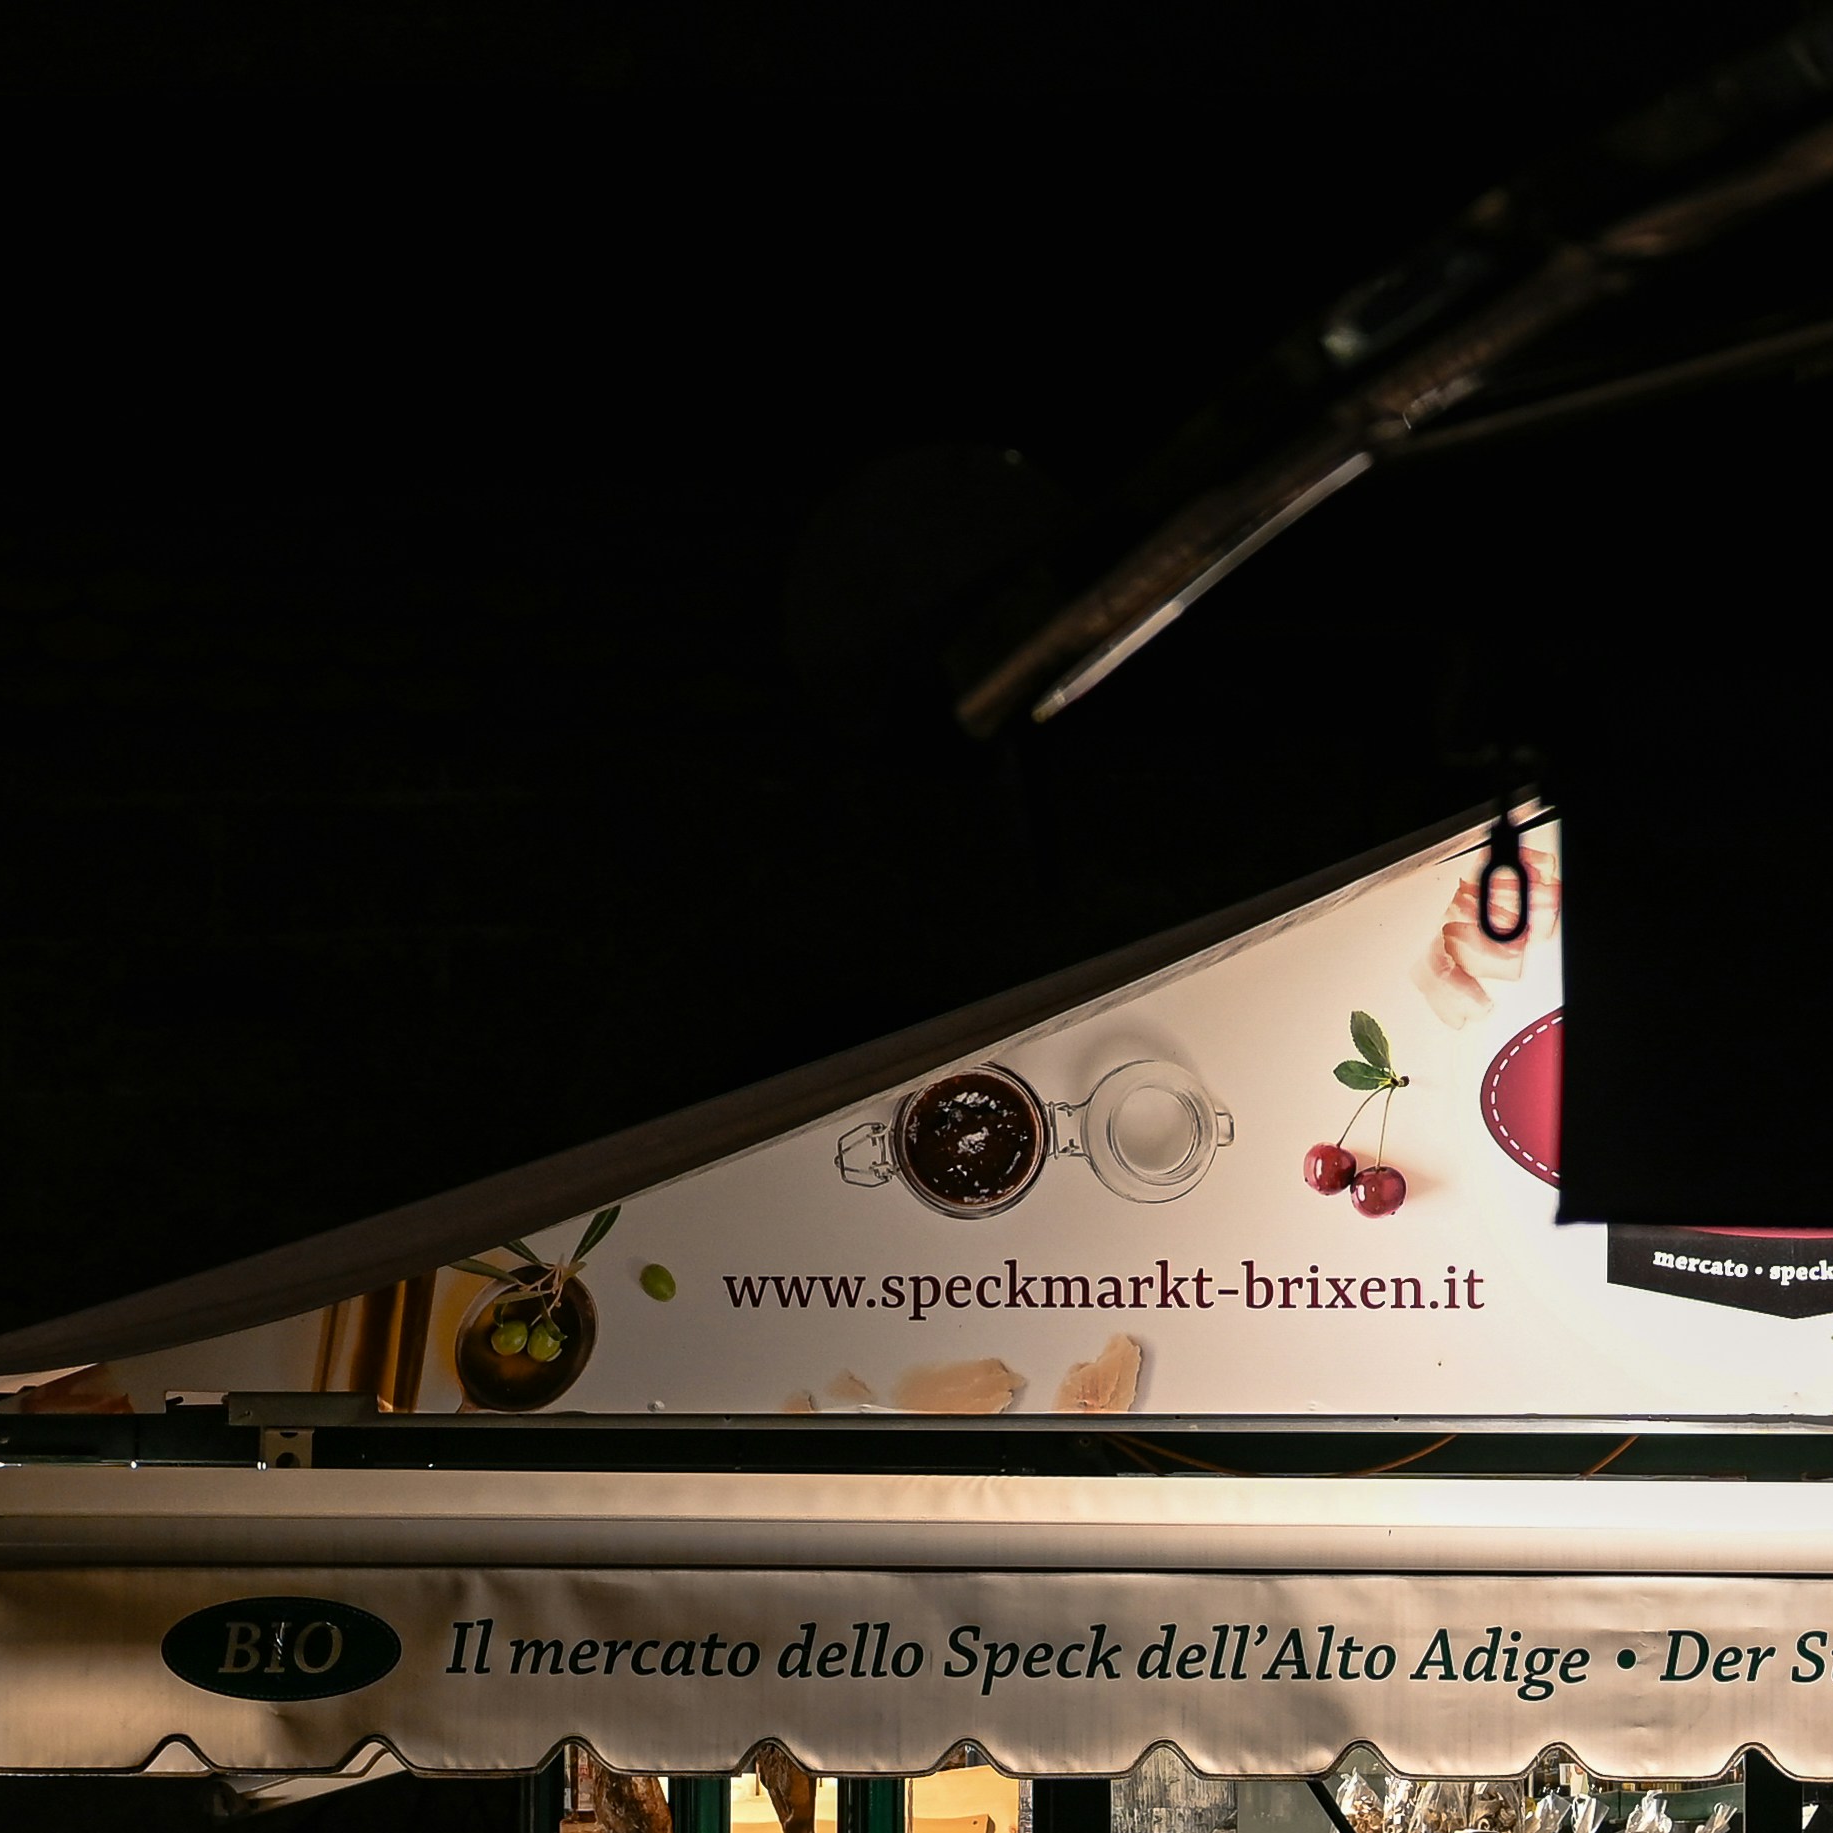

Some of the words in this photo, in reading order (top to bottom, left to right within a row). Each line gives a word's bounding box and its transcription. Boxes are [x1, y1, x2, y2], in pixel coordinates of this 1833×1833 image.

[723, 1260, 1485, 1320] www.speckmarkt-brixen.it
[1653, 1251, 1749, 1279] mercato
[218, 1621, 343, 1675] BIO
[445, 1619, 492, 1675] Il
[510, 1629, 760, 1678] mercato
[777, 1621, 924, 1679] dello
[943, 1624, 1121, 1697] Speck
[1137, 1624, 1397, 1682] dell’Alto
[1410, 1627, 1590, 1702] Adige
[1660, 1630, 1774, 1683] Der
